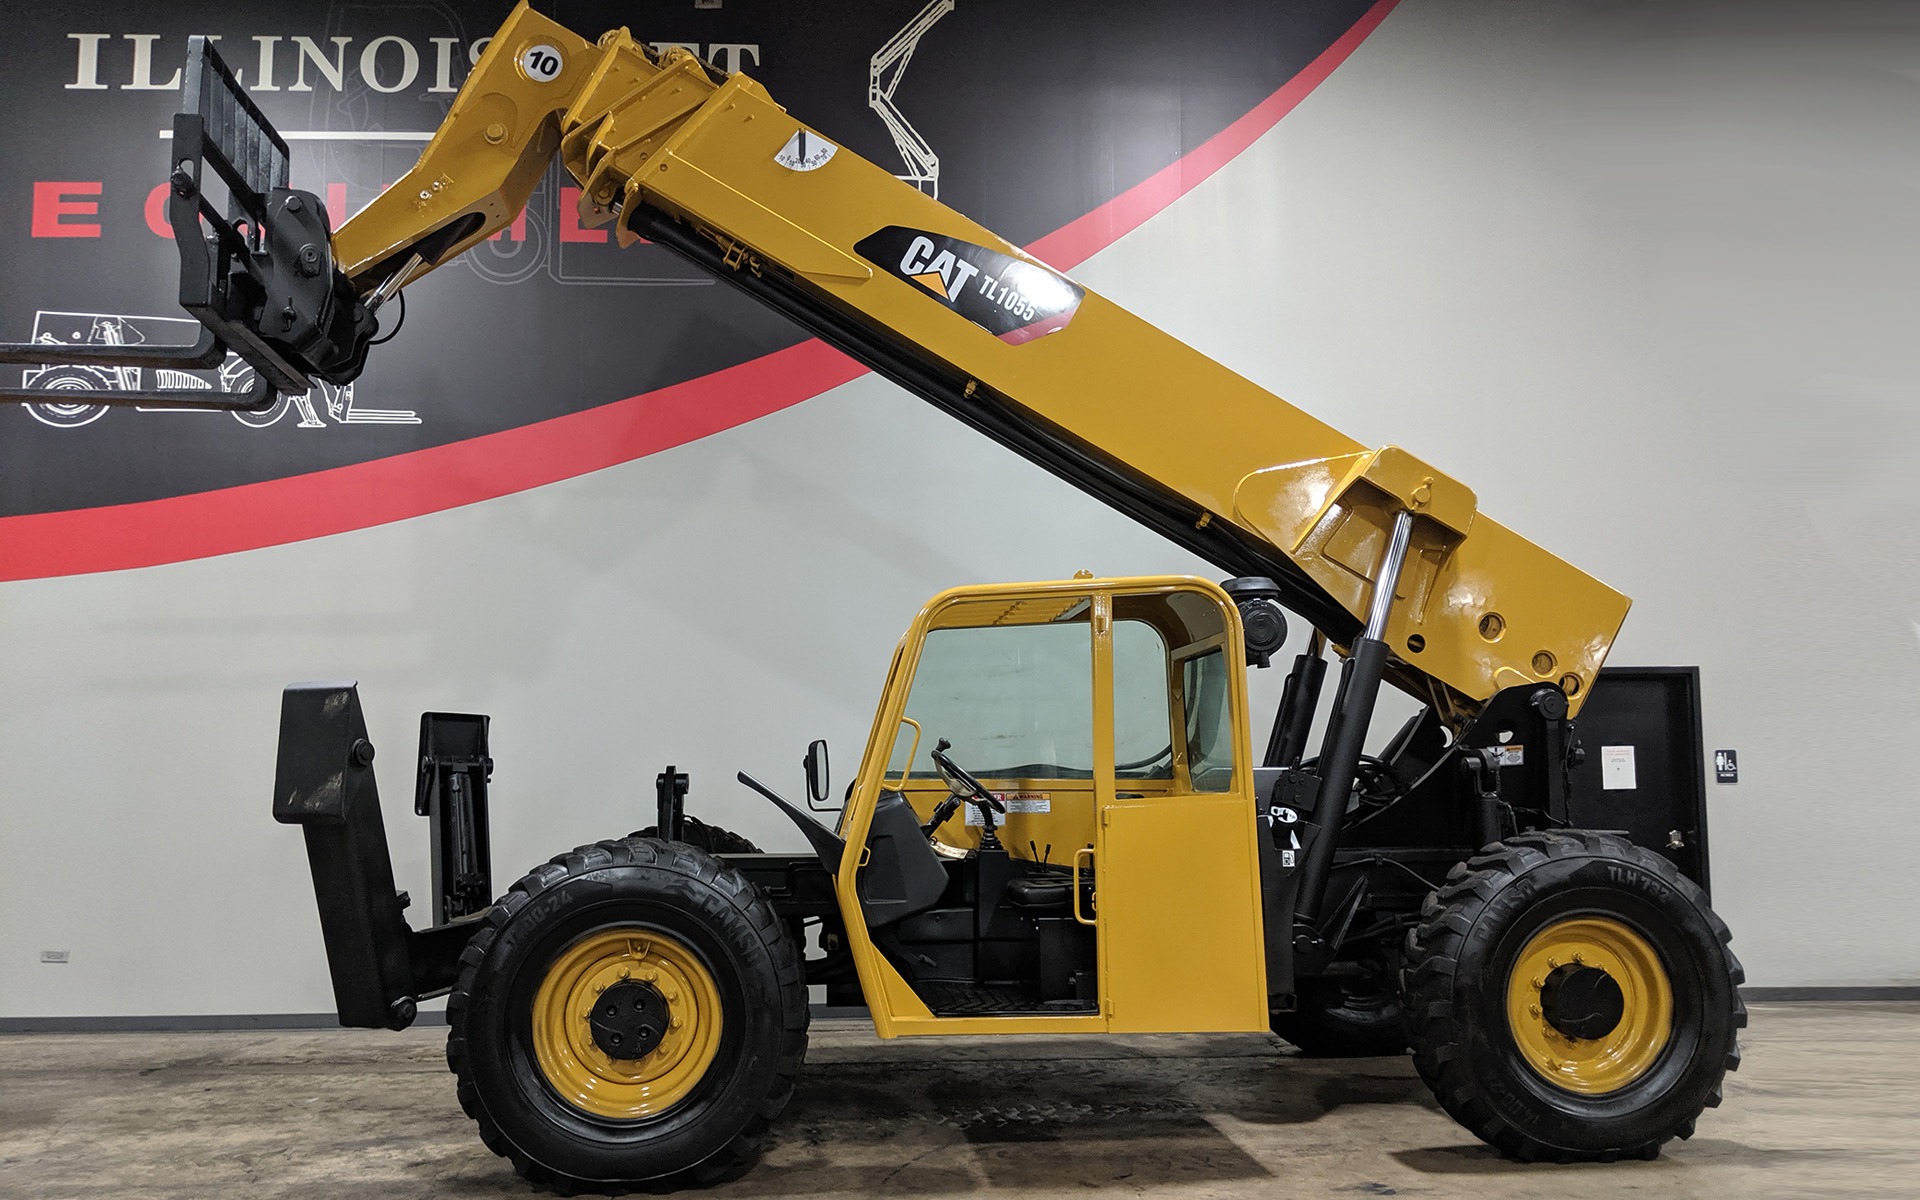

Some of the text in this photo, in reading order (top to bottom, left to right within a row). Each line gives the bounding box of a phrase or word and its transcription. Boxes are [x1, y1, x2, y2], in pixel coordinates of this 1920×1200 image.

[64, 33, 492, 93] ILINOI
[530, 51, 558, 75] 10
[900, 235, 979, 303] CAT
[979, 274, 1037, 321] TL1055
[1607, 865, 1638, 887] TLH
